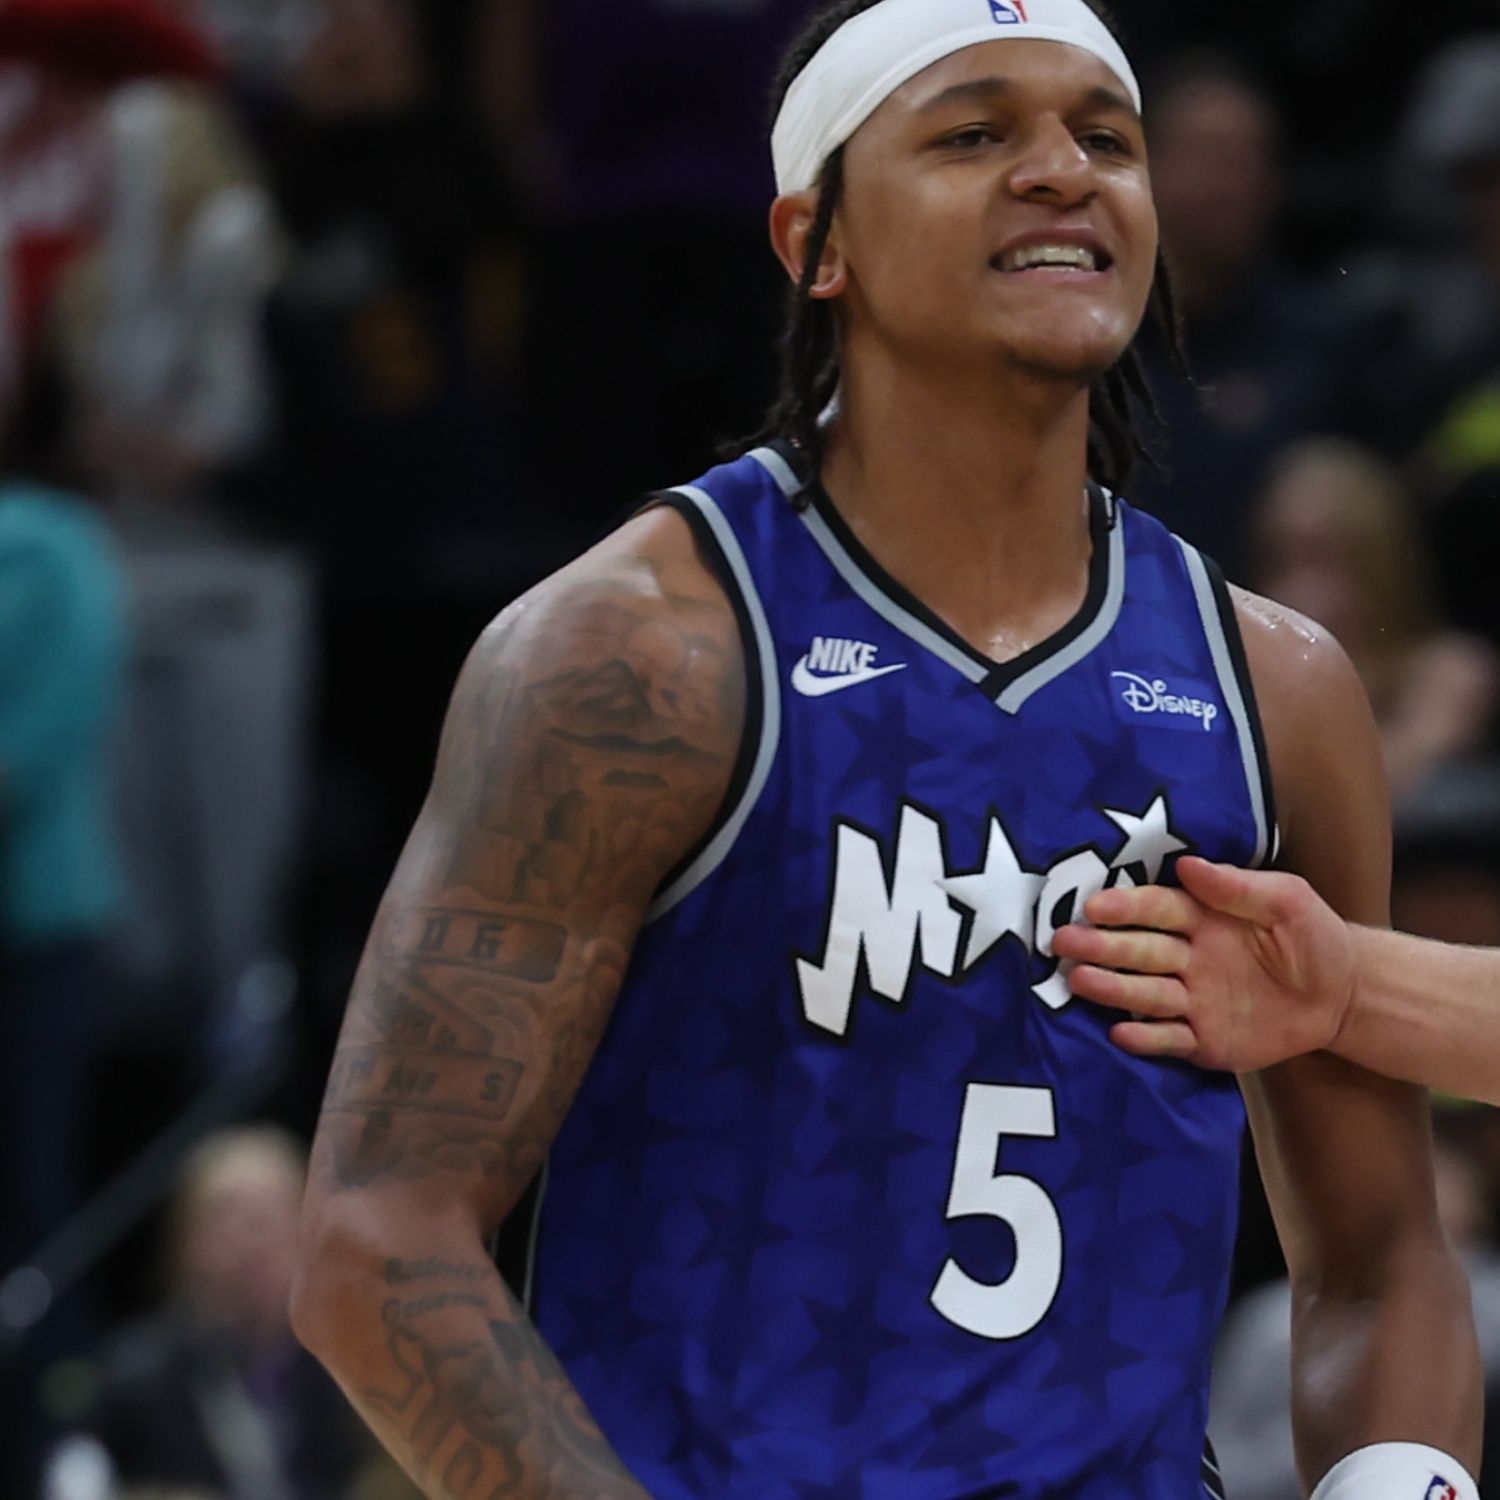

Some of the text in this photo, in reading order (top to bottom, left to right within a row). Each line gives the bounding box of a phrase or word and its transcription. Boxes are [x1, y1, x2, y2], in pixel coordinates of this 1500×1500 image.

[807, 636, 878, 674] NIKE
[796, 795, 1189, 1036] Mag
[930, 1082, 1063, 1339] 5
